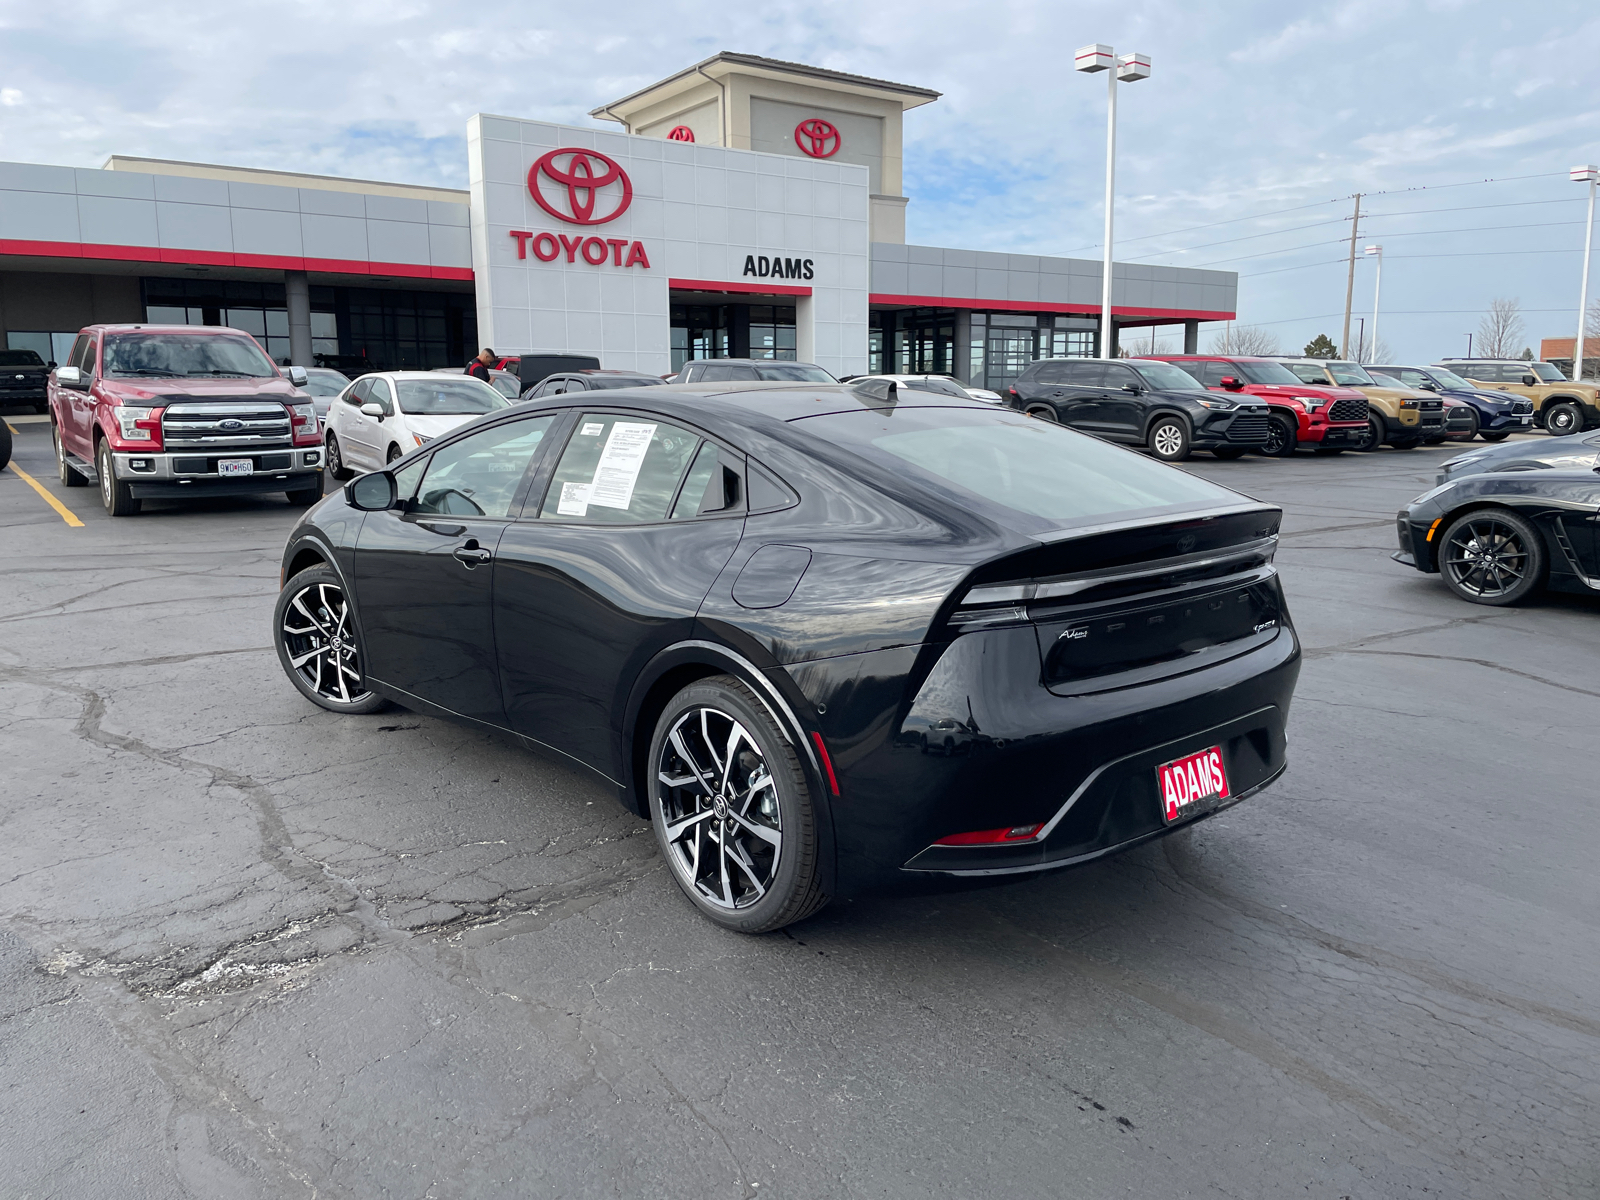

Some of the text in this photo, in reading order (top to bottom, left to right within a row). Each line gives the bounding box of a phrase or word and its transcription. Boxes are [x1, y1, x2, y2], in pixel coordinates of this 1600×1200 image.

[509, 230, 650, 268] TOYOTA
[743, 255, 814, 280] ADAMS
[1164, 751, 1224, 813] ADAMS
